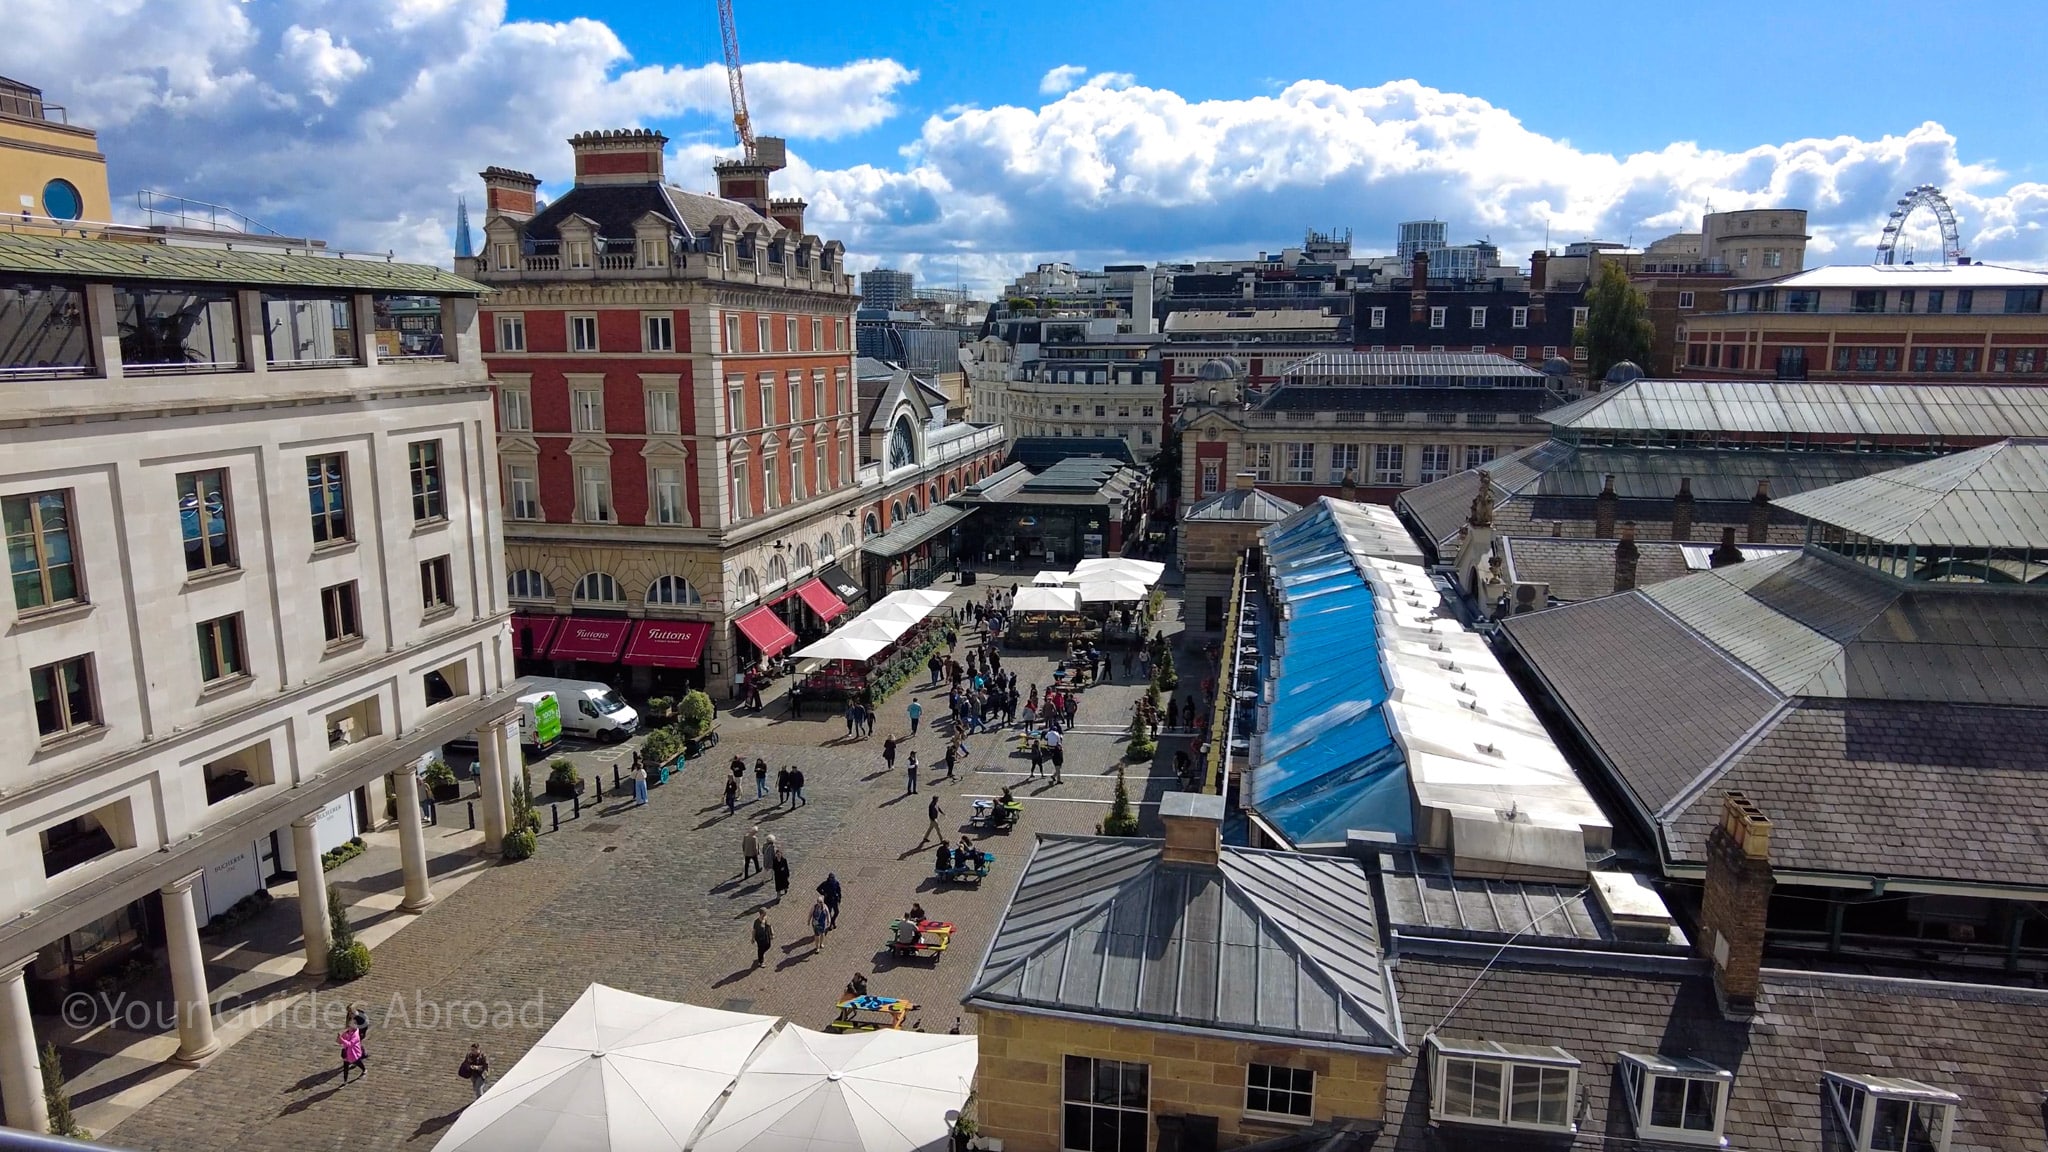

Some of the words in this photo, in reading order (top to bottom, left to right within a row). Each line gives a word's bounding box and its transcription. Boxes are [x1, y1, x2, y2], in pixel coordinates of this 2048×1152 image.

[576, 629, 610, 639] Tuttons
[647, 628, 692, 641] Tuttons
[214, 854, 244, 872] BUCHERER
